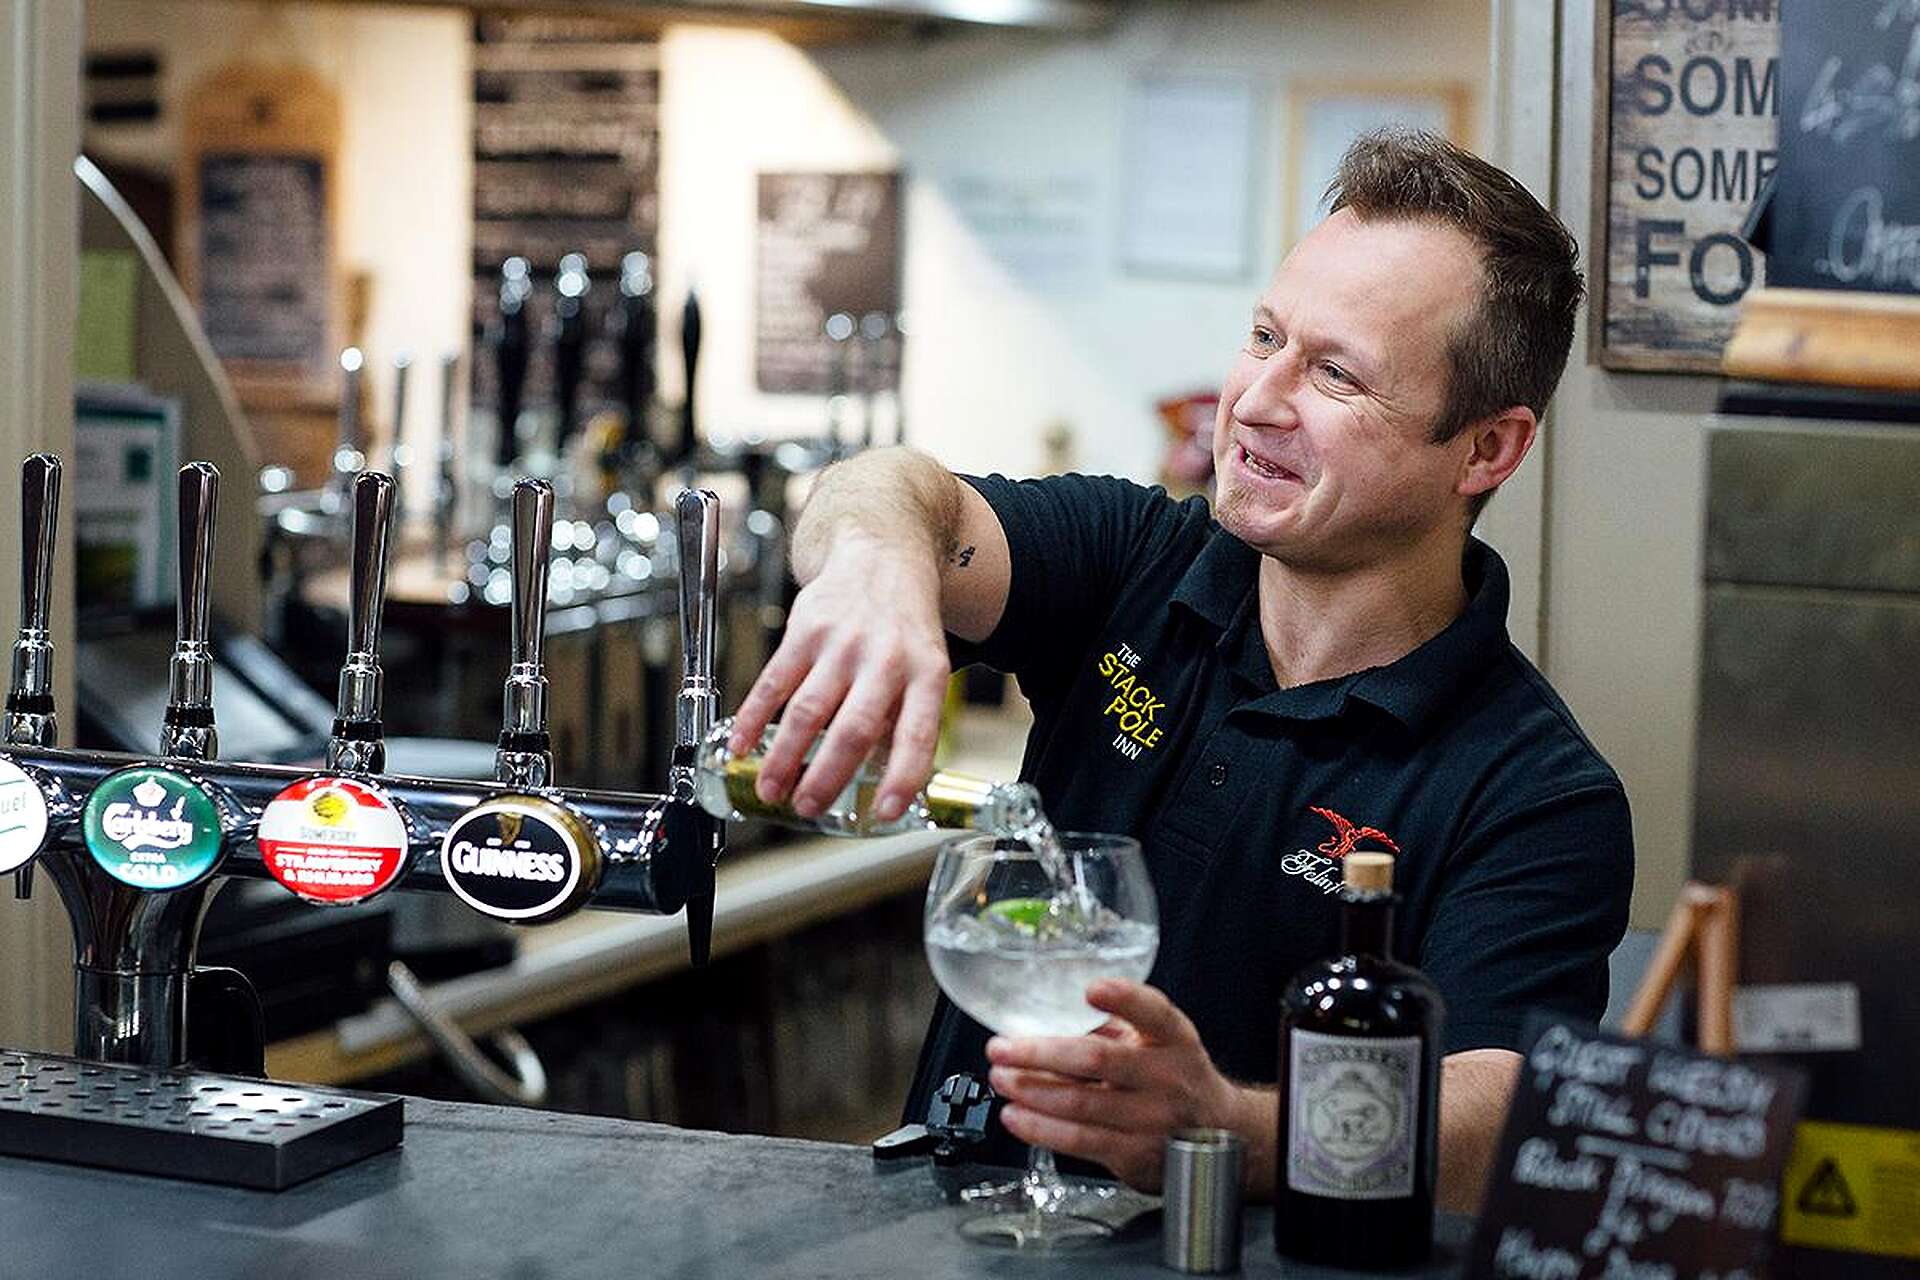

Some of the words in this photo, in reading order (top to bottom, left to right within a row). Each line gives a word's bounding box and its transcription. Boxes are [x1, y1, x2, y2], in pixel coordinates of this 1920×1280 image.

[1116, 643, 1142, 668] THE
[1098, 652, 1166, 722] STACK
[1103, 695, 1164, 748] POLE
[1112, 733, 1143, 760] INN
[102, 796, 193, 850] Carlsberg
[451, 841, 565, 882] GUINNESS
